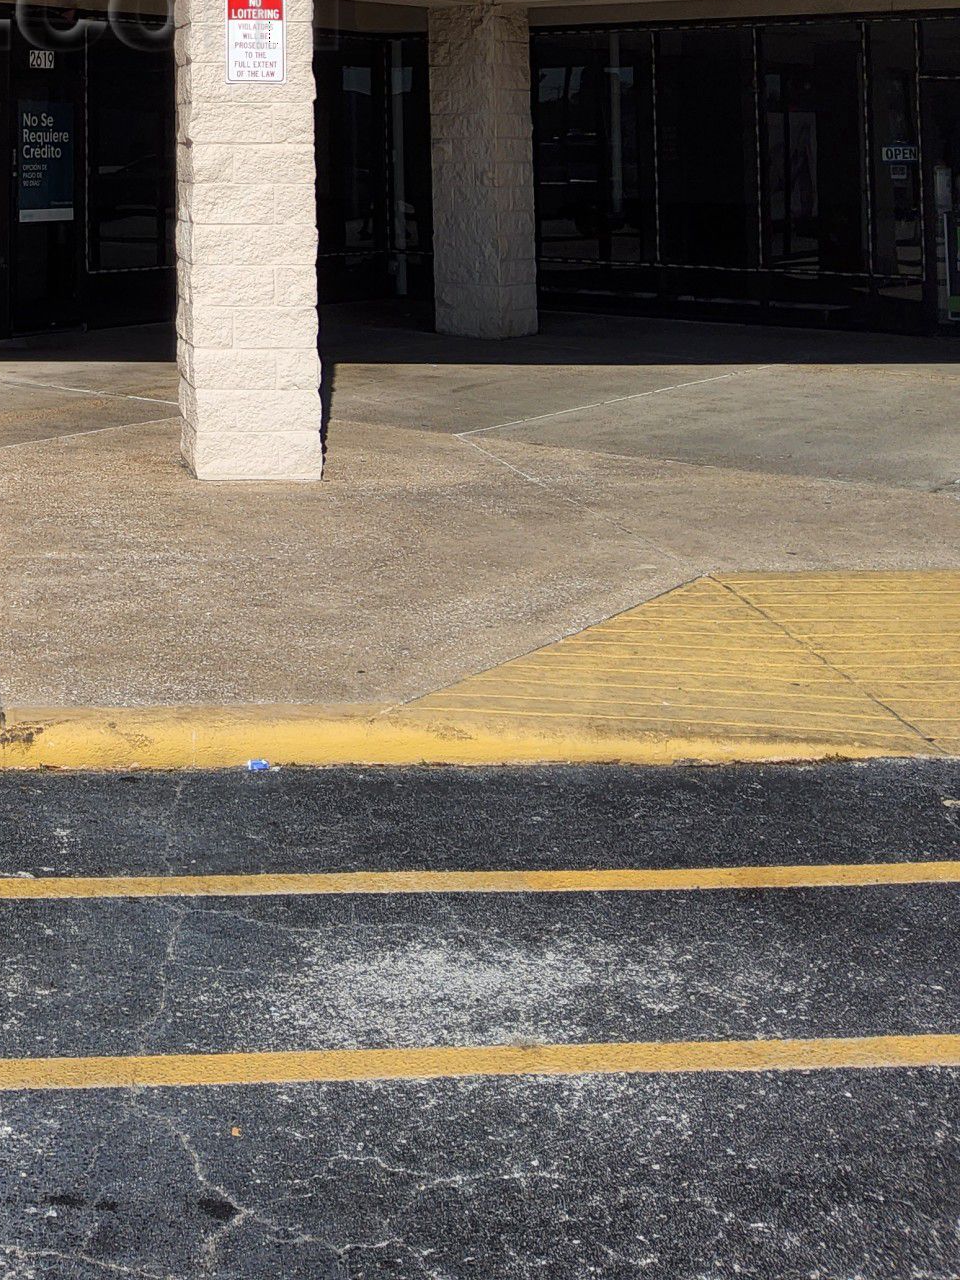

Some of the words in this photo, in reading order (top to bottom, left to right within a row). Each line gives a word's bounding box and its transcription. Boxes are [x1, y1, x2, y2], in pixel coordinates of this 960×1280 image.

[231, 9, 280, 19] LOITERING
[30, 51, 54, 68] 2619
[23, 113, 38, 127] No
[41, 113, 54, 127] Se
[23, 129, 69, 146] Requiere
[23, 144, 62, 158] Crédito
[885, 148, 917, 160] OPEN
